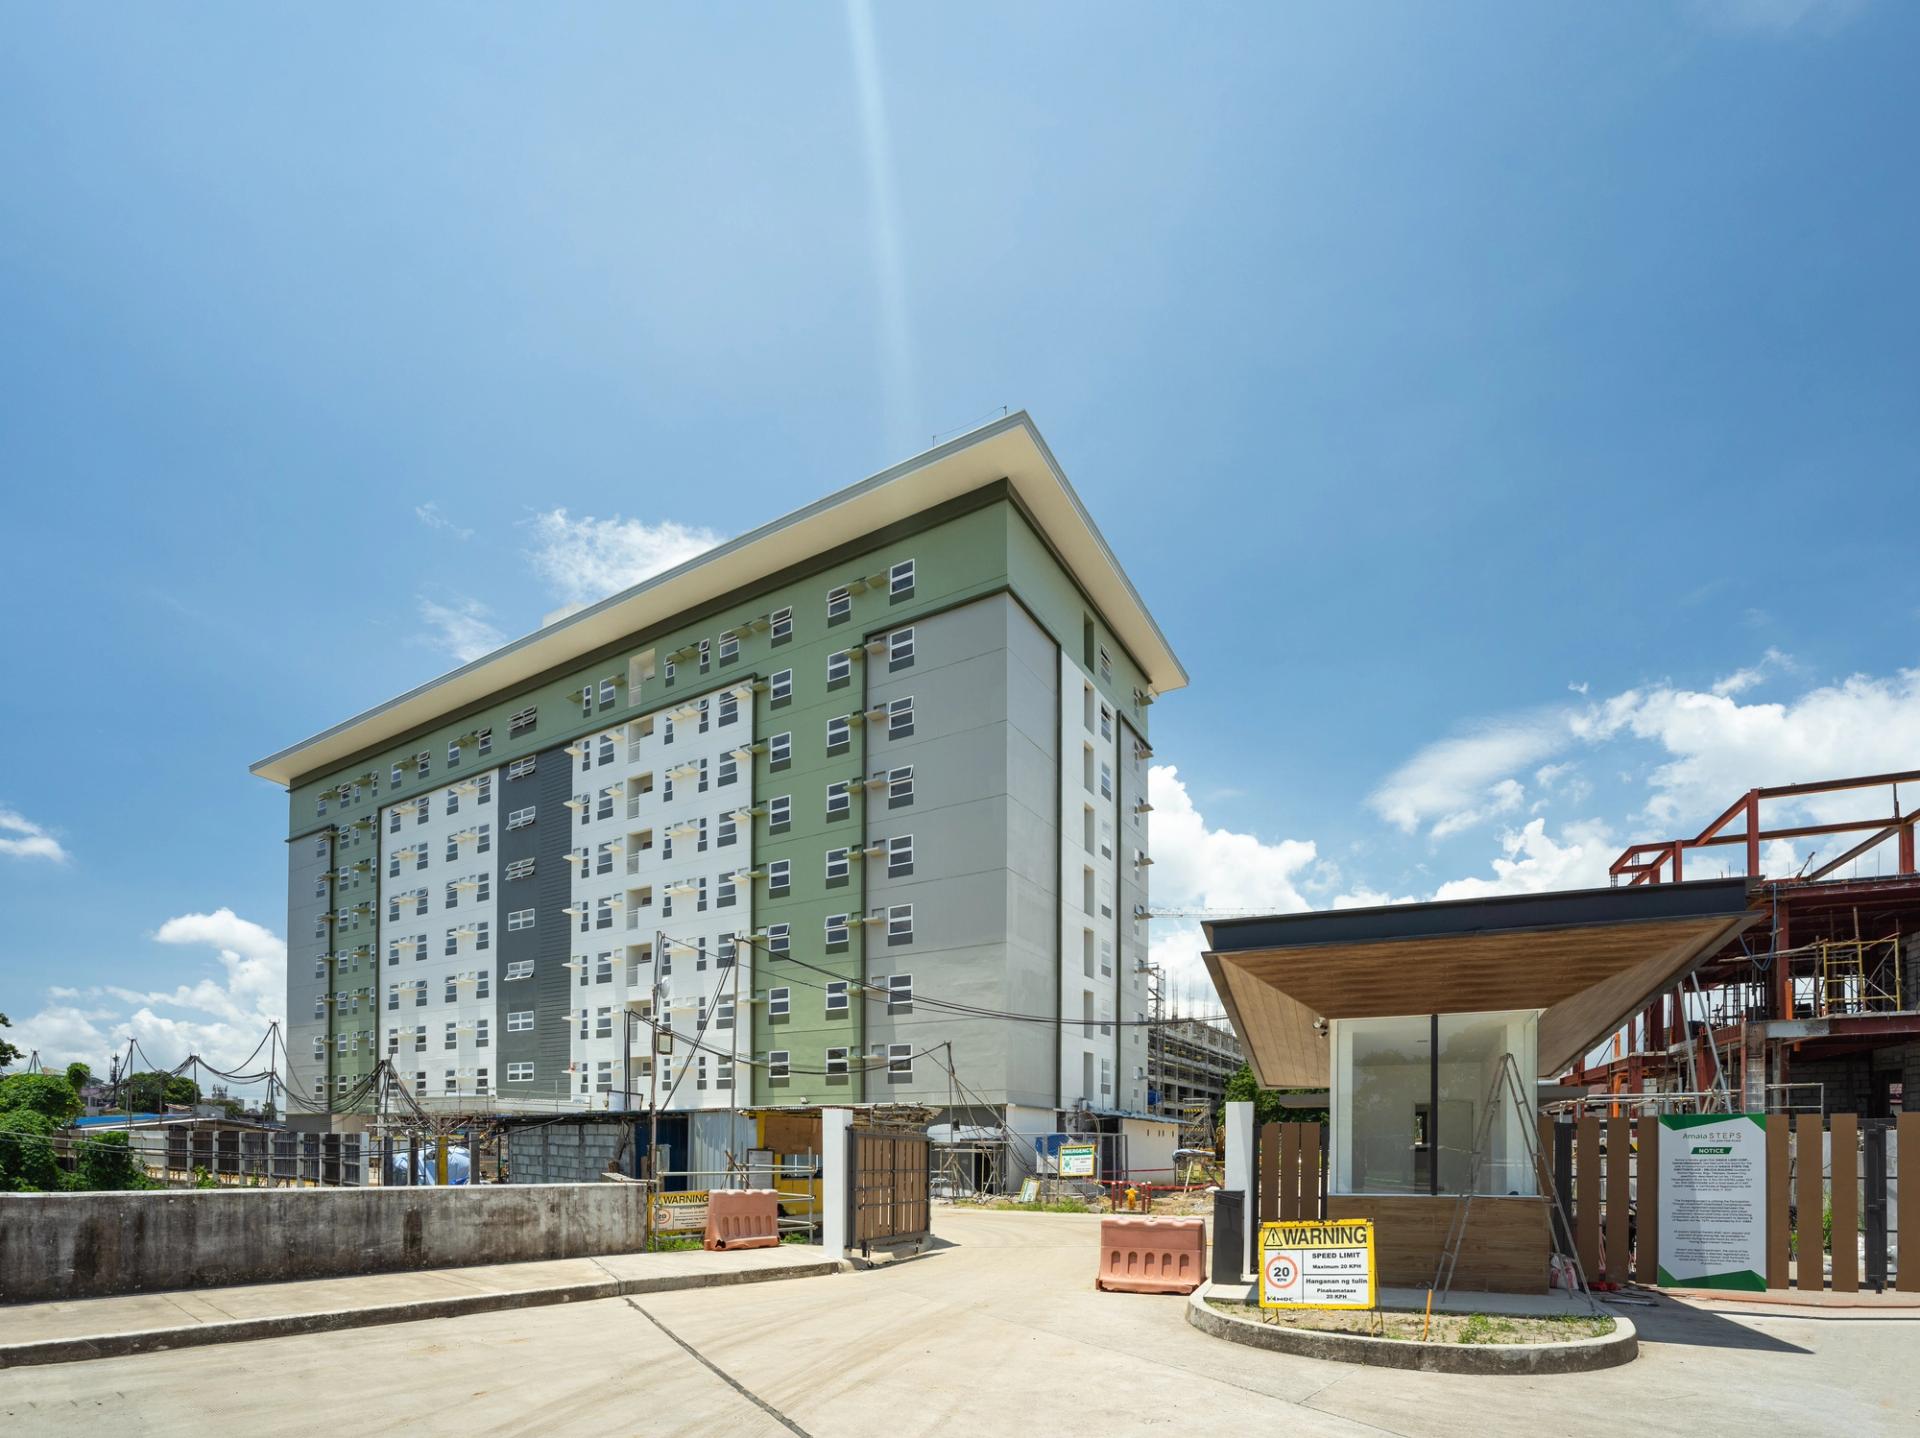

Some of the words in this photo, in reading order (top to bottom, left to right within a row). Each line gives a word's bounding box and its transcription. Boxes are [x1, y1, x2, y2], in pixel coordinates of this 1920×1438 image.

[663, 1194, 709, 1204] WARNING
[1282, 1226, 1367, 1245] WARNING
[1273, 1267, 1290, 1277] 20
